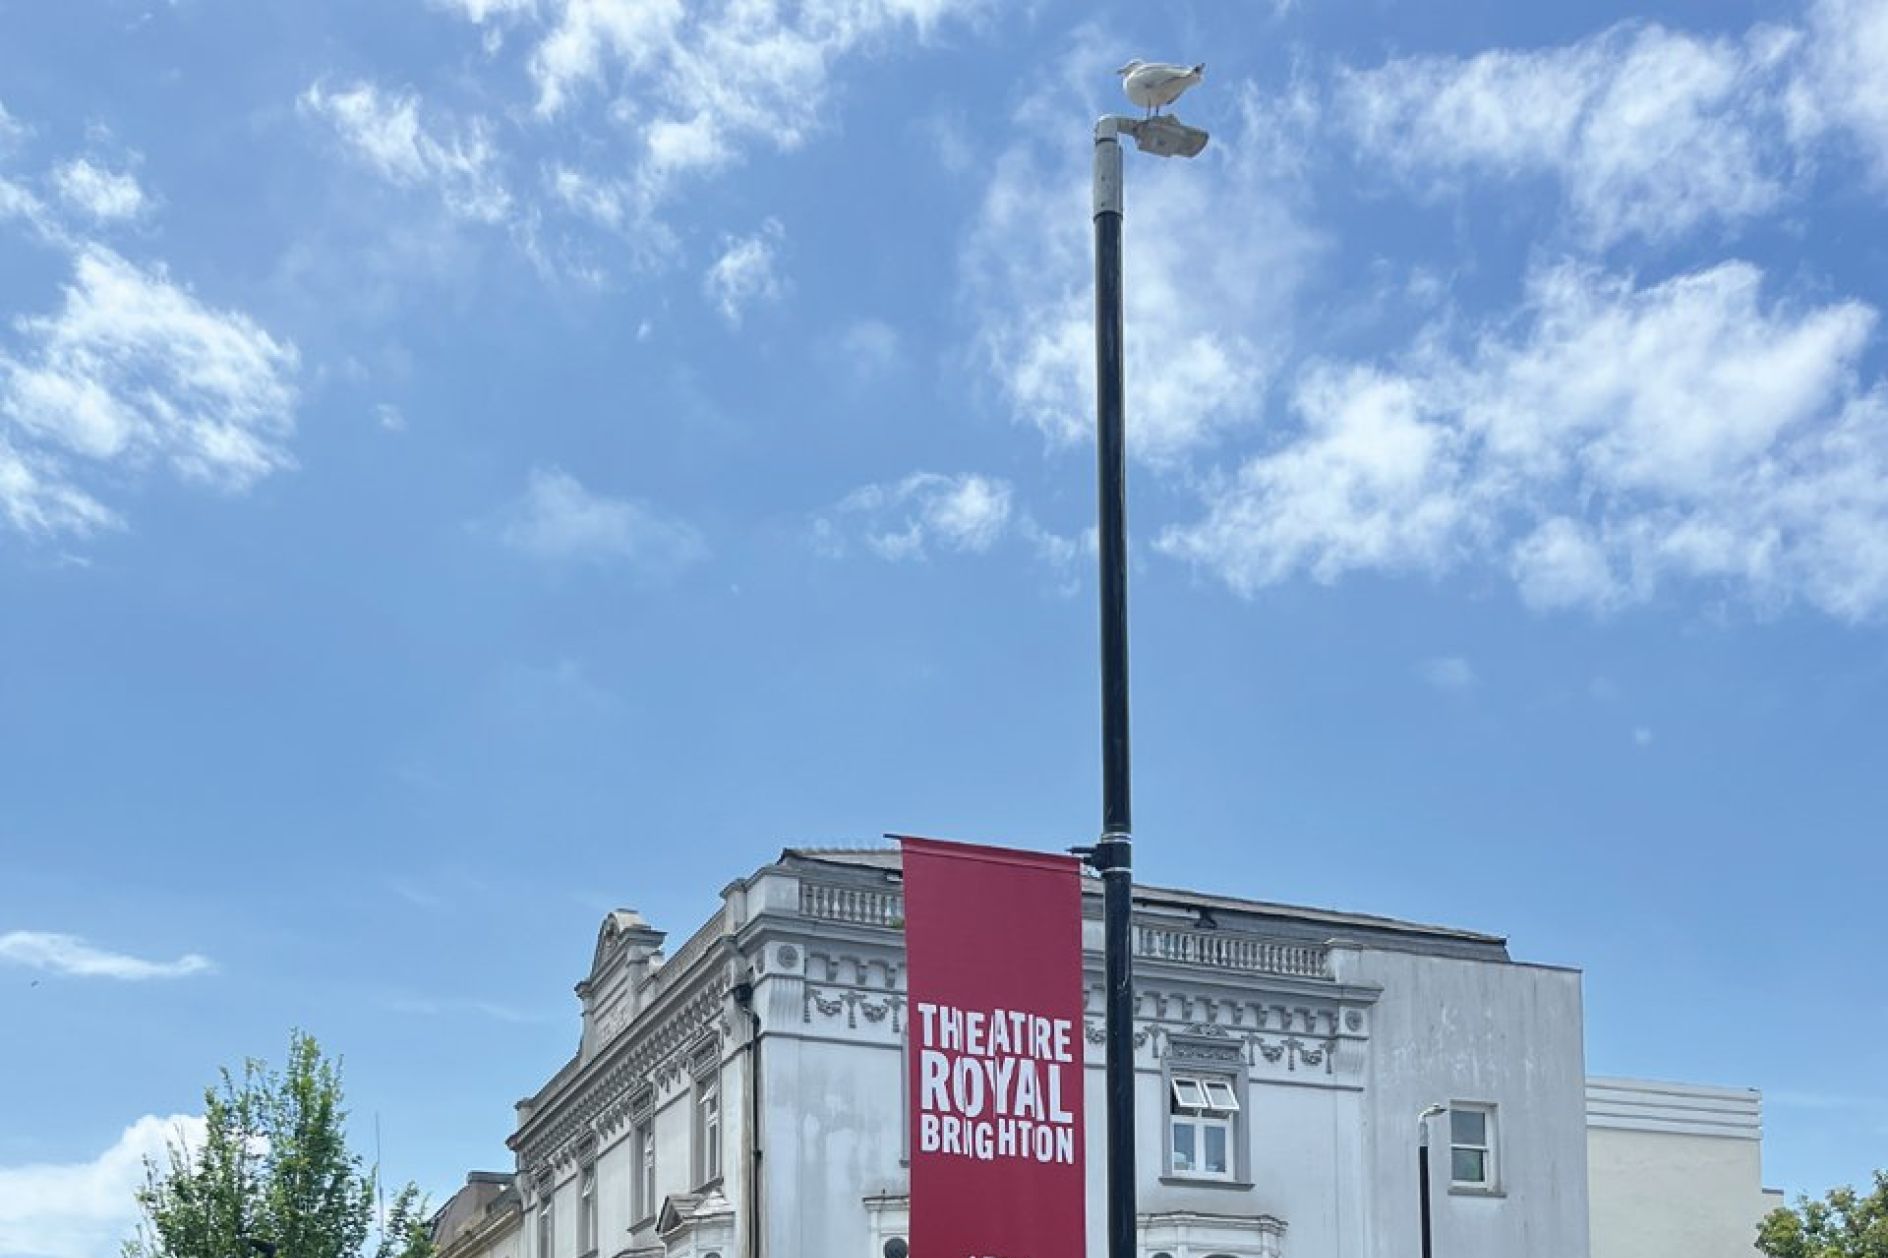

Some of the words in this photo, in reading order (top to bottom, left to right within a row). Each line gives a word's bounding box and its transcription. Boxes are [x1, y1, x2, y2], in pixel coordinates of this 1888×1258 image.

[918, 1002, 1073, 1063] THEATRE
[921, 1050, 1073, 1123] ROYAL
[921, 1114, 1074, 1165] BRIGHTON
